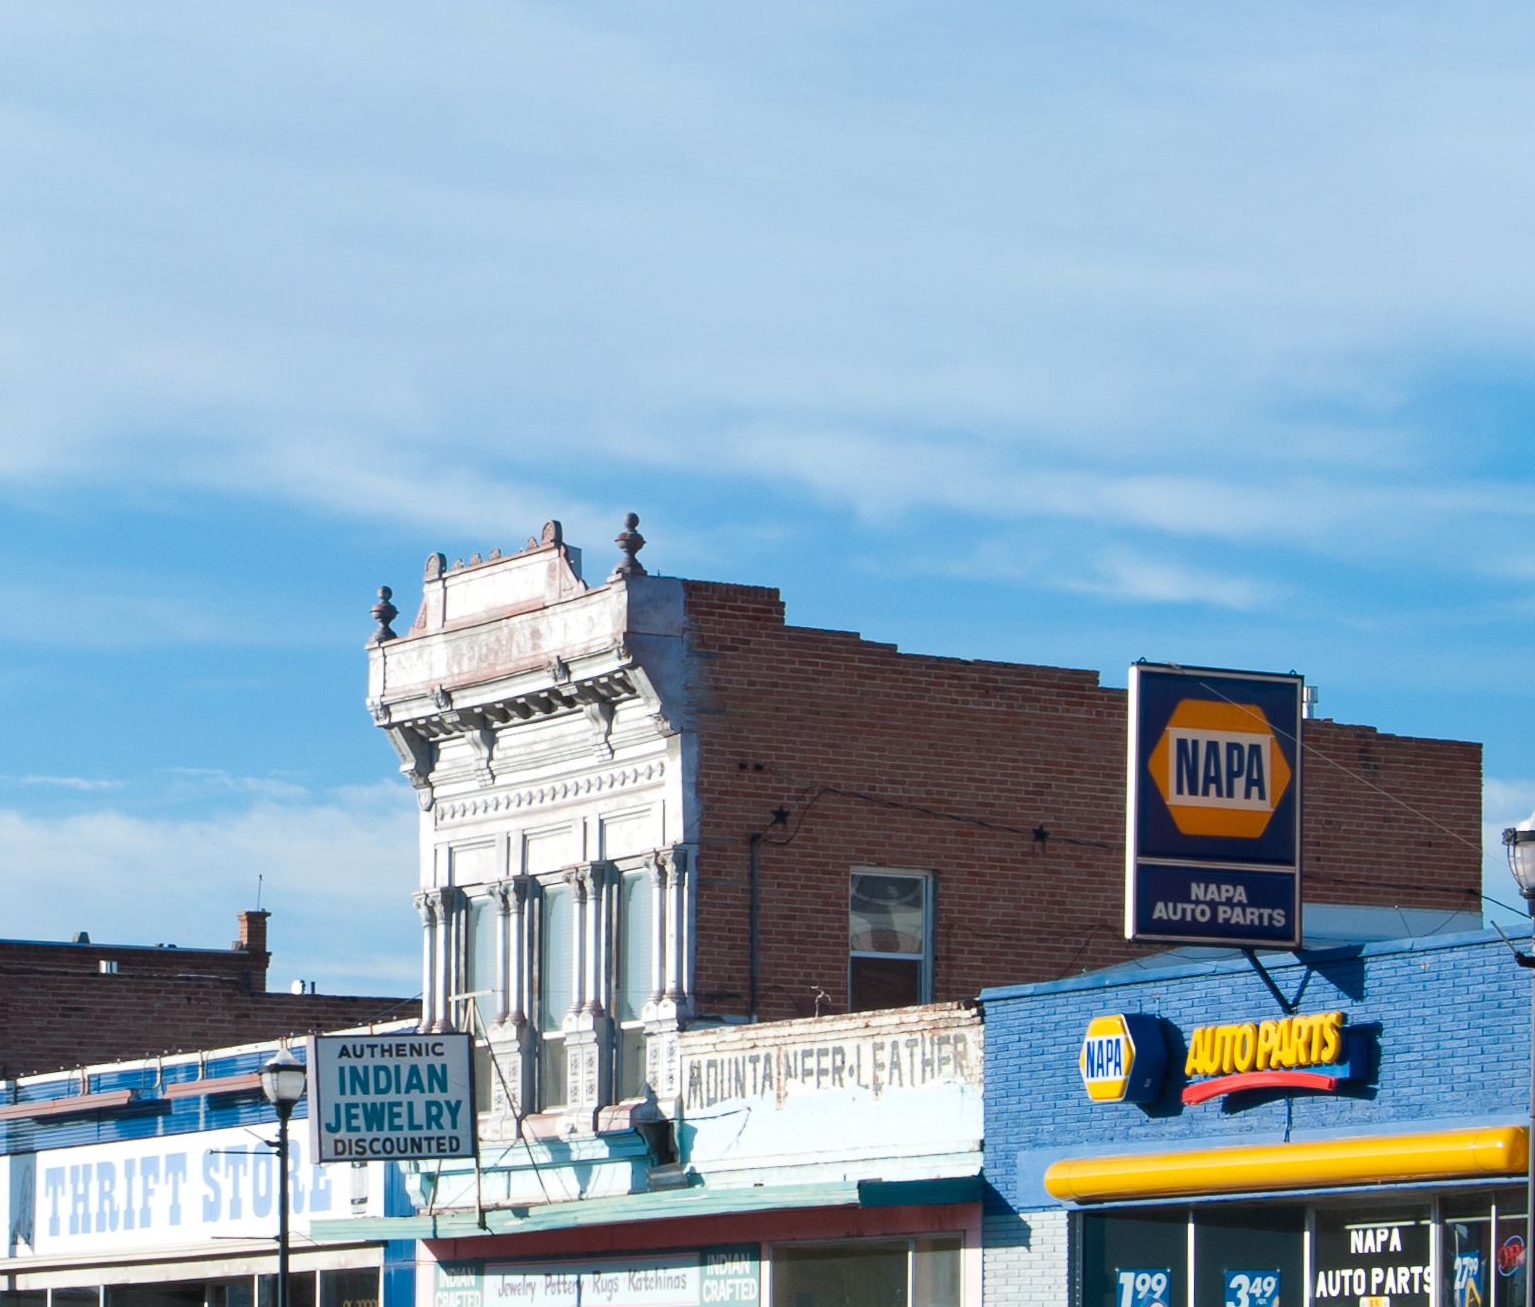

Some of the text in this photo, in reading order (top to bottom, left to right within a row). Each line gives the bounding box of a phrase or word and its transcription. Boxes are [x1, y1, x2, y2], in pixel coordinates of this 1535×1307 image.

[1175, 737, 1266, 801] NAPA
[1190, 882, 1248, 904] NAPA
[1152, 901, 1286, 927] AUTO PARTS
[337, 1042, 445, 1059] AUTHENIC
[1085, 1037, 1122, 1079] NAPA
[1184, 1011, 1343, 1076] AUTO PARTS
[338, 1063, 448, 1096] INDIAN
[687, 1046, 846, 1110] MOUNTANEER
[857, 1033, 967, 1094] LEATHER
[324, 1100, 463, 1133] JEWELRY
[334, 1136, 461, 1156] DISCOUNTED
[45, 1138, 333, 1237] THRIFT STORE
[1350, 1228, 1402, 1253] NAPA
[438, 1266, 476, 1288] INDIAN
[706, 1253, 751, 1275] INDIAN
[497, 1268, 687, 1303] Jewelry Pottery Rugs Katchinas
[702, 1278, 757, 1303] CRAFTED
[1315, 1265, 1432, 1298] AUTO PARTS
